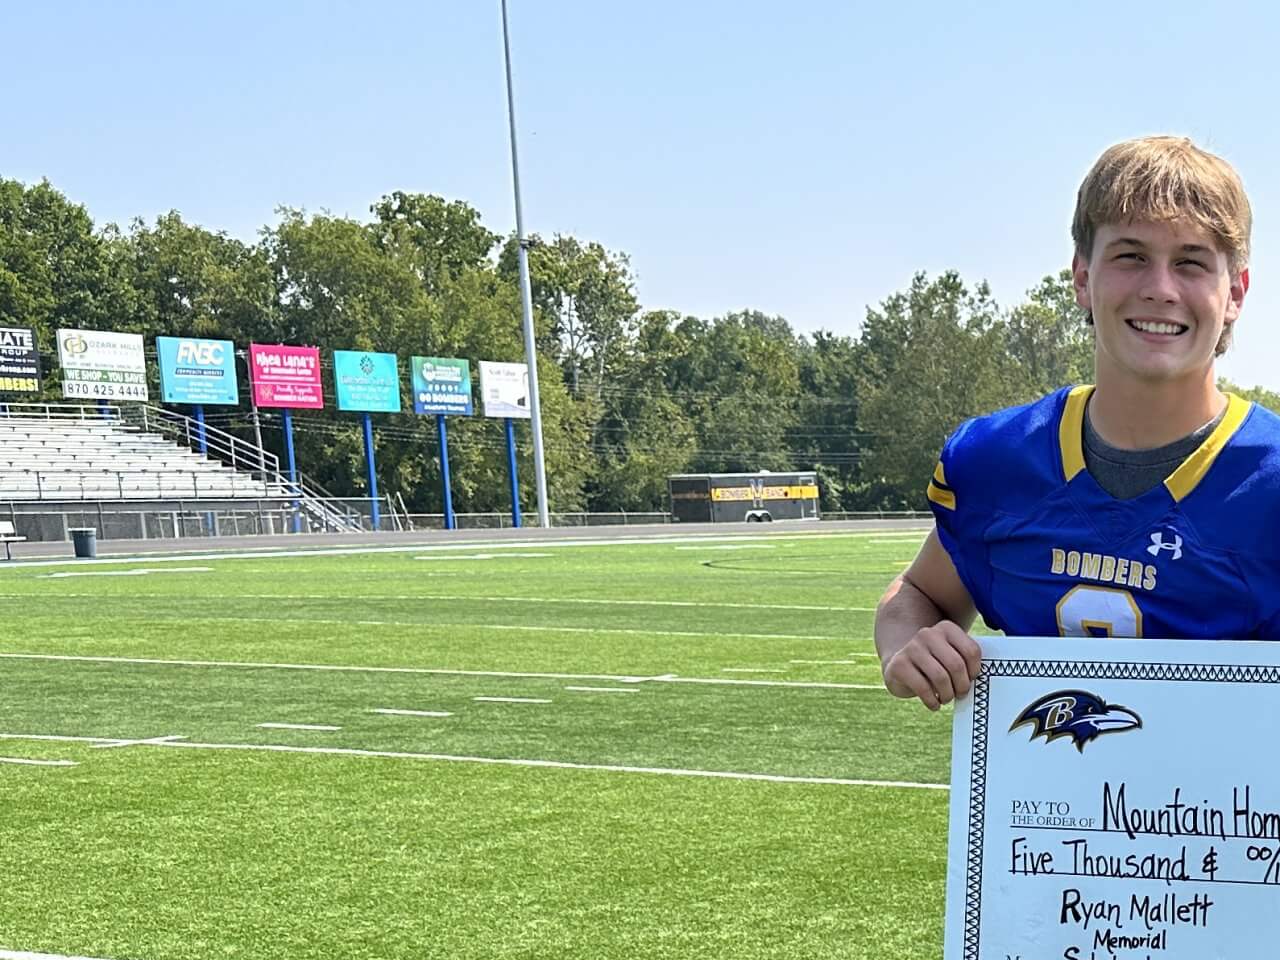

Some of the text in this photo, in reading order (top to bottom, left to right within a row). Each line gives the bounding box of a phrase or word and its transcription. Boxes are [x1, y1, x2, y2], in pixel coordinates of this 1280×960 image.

[176, 342, 224, 366] FNBC
[67, 370, 80, 380] WE
[82, 371, 102, 381] SHOP
[109, 373, 123, 382] YOU
[125, 374, 145, 383] SAVE
[67, 383, 146, 397] 870 425 4444
[1051, 547, 1157, 591] BOMBERS
[1011, 800, 1070, 816] PAY TO
[1103, 782, 1226, 841] Mountain
[1011, 815, 1095, 828] THE ORDER OF
[1011, 837, 1054, 876] Five
[1062, 838, 1190, 885] Thousand
[1060, 888, 1213, 929] Ryan Mallett
[1093, 929, 1166, 954] Memorial
